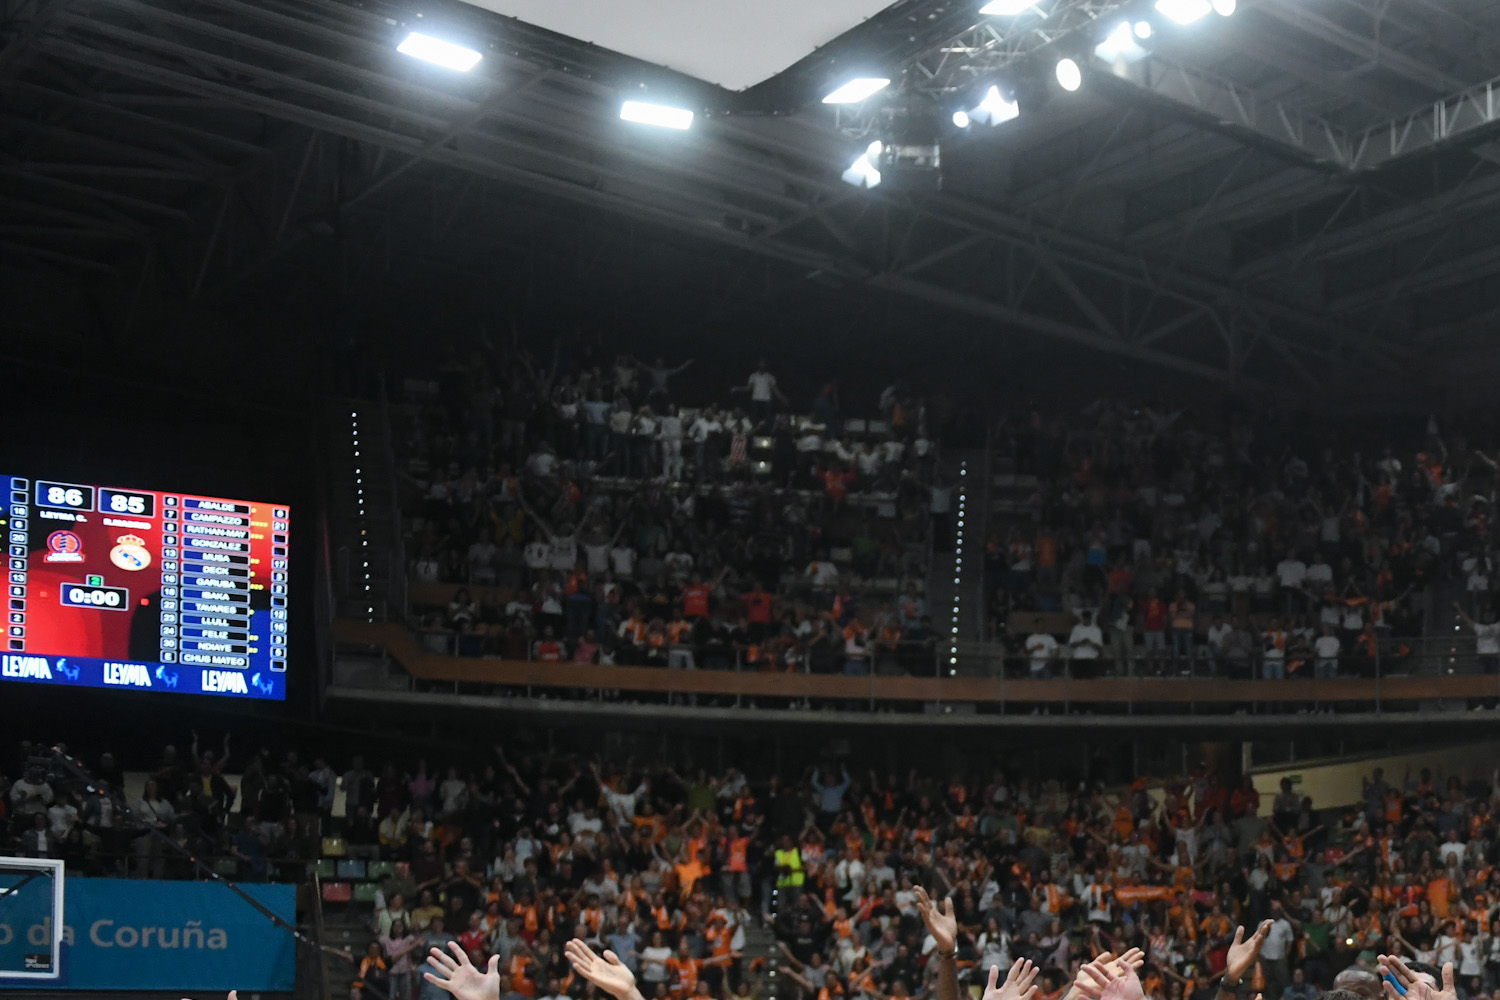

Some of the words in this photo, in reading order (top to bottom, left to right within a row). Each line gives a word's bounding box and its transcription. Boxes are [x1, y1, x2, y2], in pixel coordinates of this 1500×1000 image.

[48, 487, 83, 506] 86
[110, 494, 145, 513] 85
[198, 501, 235, 512] ABALDE
[191, 513, 242, 526] CAMPAZZO
[187, 525, 246, 539] RATHAN-MAY
[191, 539, 241, 551] GONZALEZ
[202, 552, 231, 563] MUSA
[202, 566, 230, 576] DECK
[91, 576, 100, 585] 2
[196, 578, 236, 589] GARUBA
[69, 588, 120, 606] 0:00
[201, 591, 230, 601] IBAKA
[195, 603, 237, 614] TAVARES
[201, 617, 230, 627] LLULL
[202, 630, 229, 640] FELIZ
[198, 642, 232, 653] NDIAYE
[184, 654, 211, 663] CHUS
[212, 655, 245, 666] MATEO
[2, 655, 52, 679] LEYMA
[104, 663, 152, 687] LEYMA
[202, 670, 248, 694] LEYMA
[89, 920, 228, 950] Coruña
